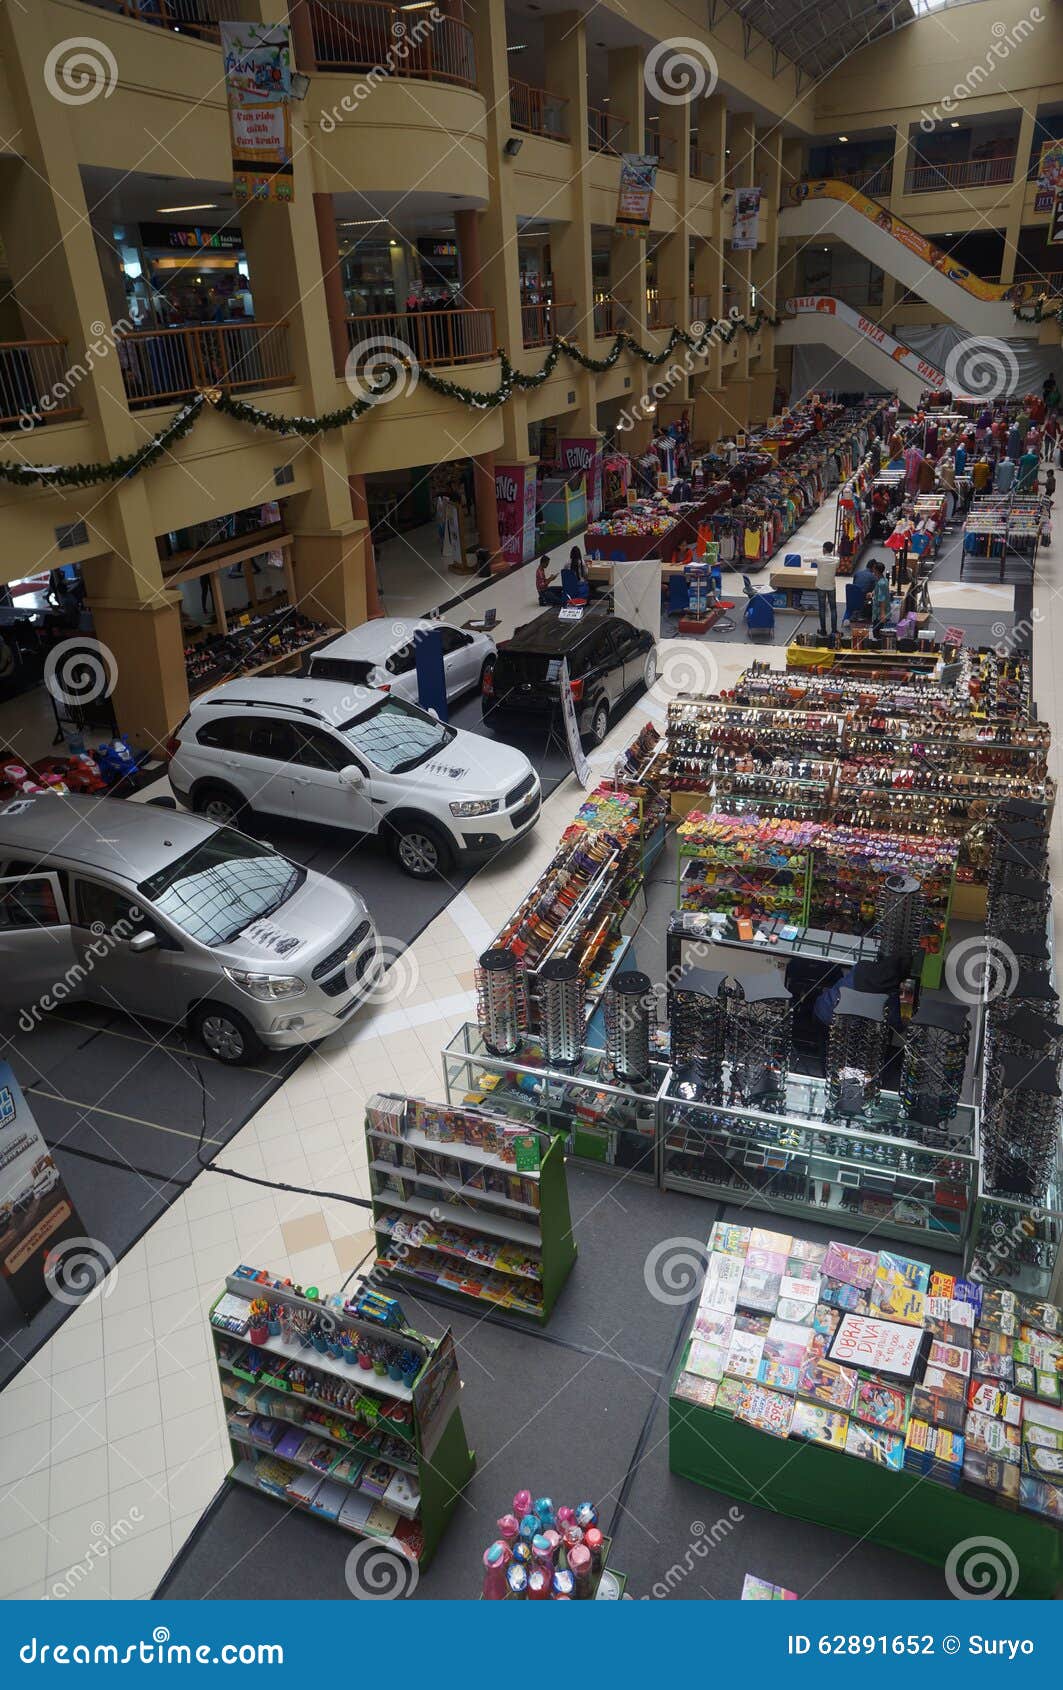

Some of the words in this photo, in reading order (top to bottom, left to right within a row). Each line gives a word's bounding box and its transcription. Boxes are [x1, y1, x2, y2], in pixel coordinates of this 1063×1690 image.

[938, 1277, 954, 1298] PNS
[835, 1315, 866, 1359] OBRAL
[856, 1322, 882, 1355] DIVA
[769, 1402, 785, 1423] 365
